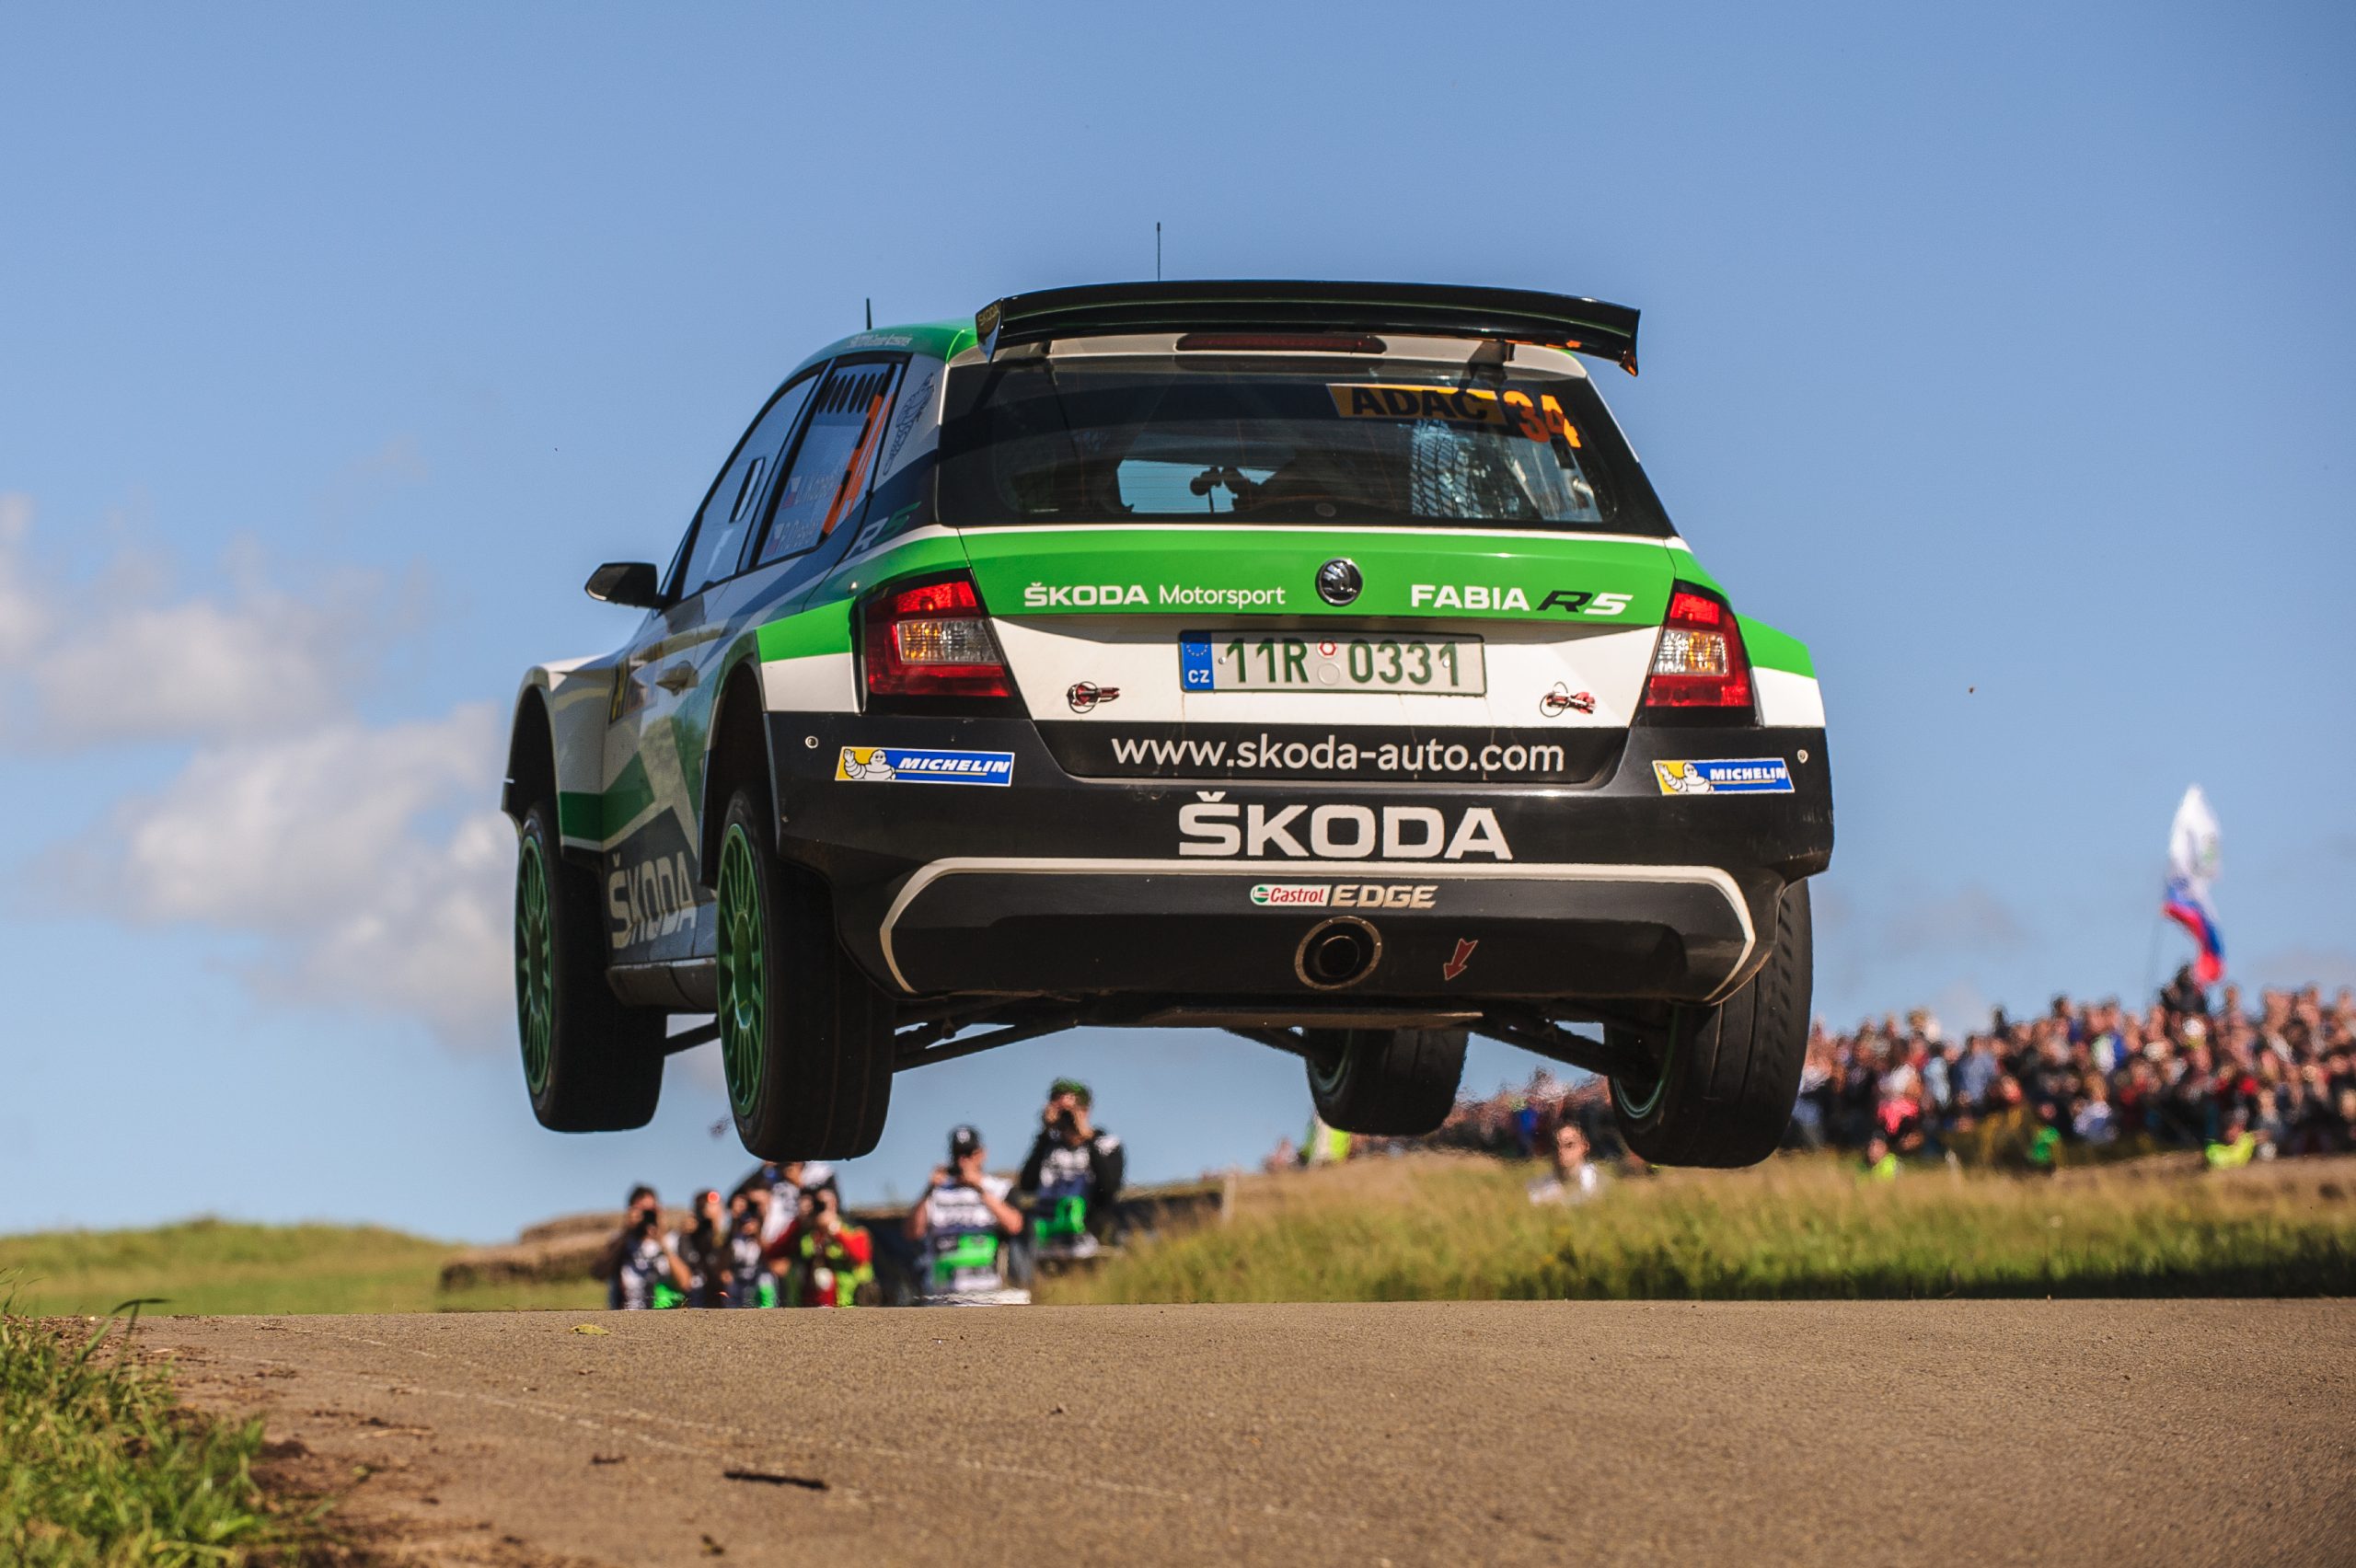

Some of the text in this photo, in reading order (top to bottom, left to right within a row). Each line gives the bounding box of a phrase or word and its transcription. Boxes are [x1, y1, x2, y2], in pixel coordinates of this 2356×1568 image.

[1352, 387, 1489, 421] ADAC
[1503, 390, 1582, 449] 34
[845, 501, 922, 558] R5
[1024, 582, 1287, 610] ŠKODA Motorsport
[1411, 584, 1634, 616] FABIA R5
[1187, 670, 1210, 684] CZ
[1225, 637, 1460, 686] 11R 0331
[898, 757, 1011, 774] MICHELIN
[1111, 732, 1565, 773] www.skoda-auto.com
[1709, 767, 1787, 781] MICHELIN
[1178, 790, 1514, 861] ŠKODA
[608, 850, 698, 950] ŠKODA
[1270, 884, 1439, 909] Castrol EDGE
